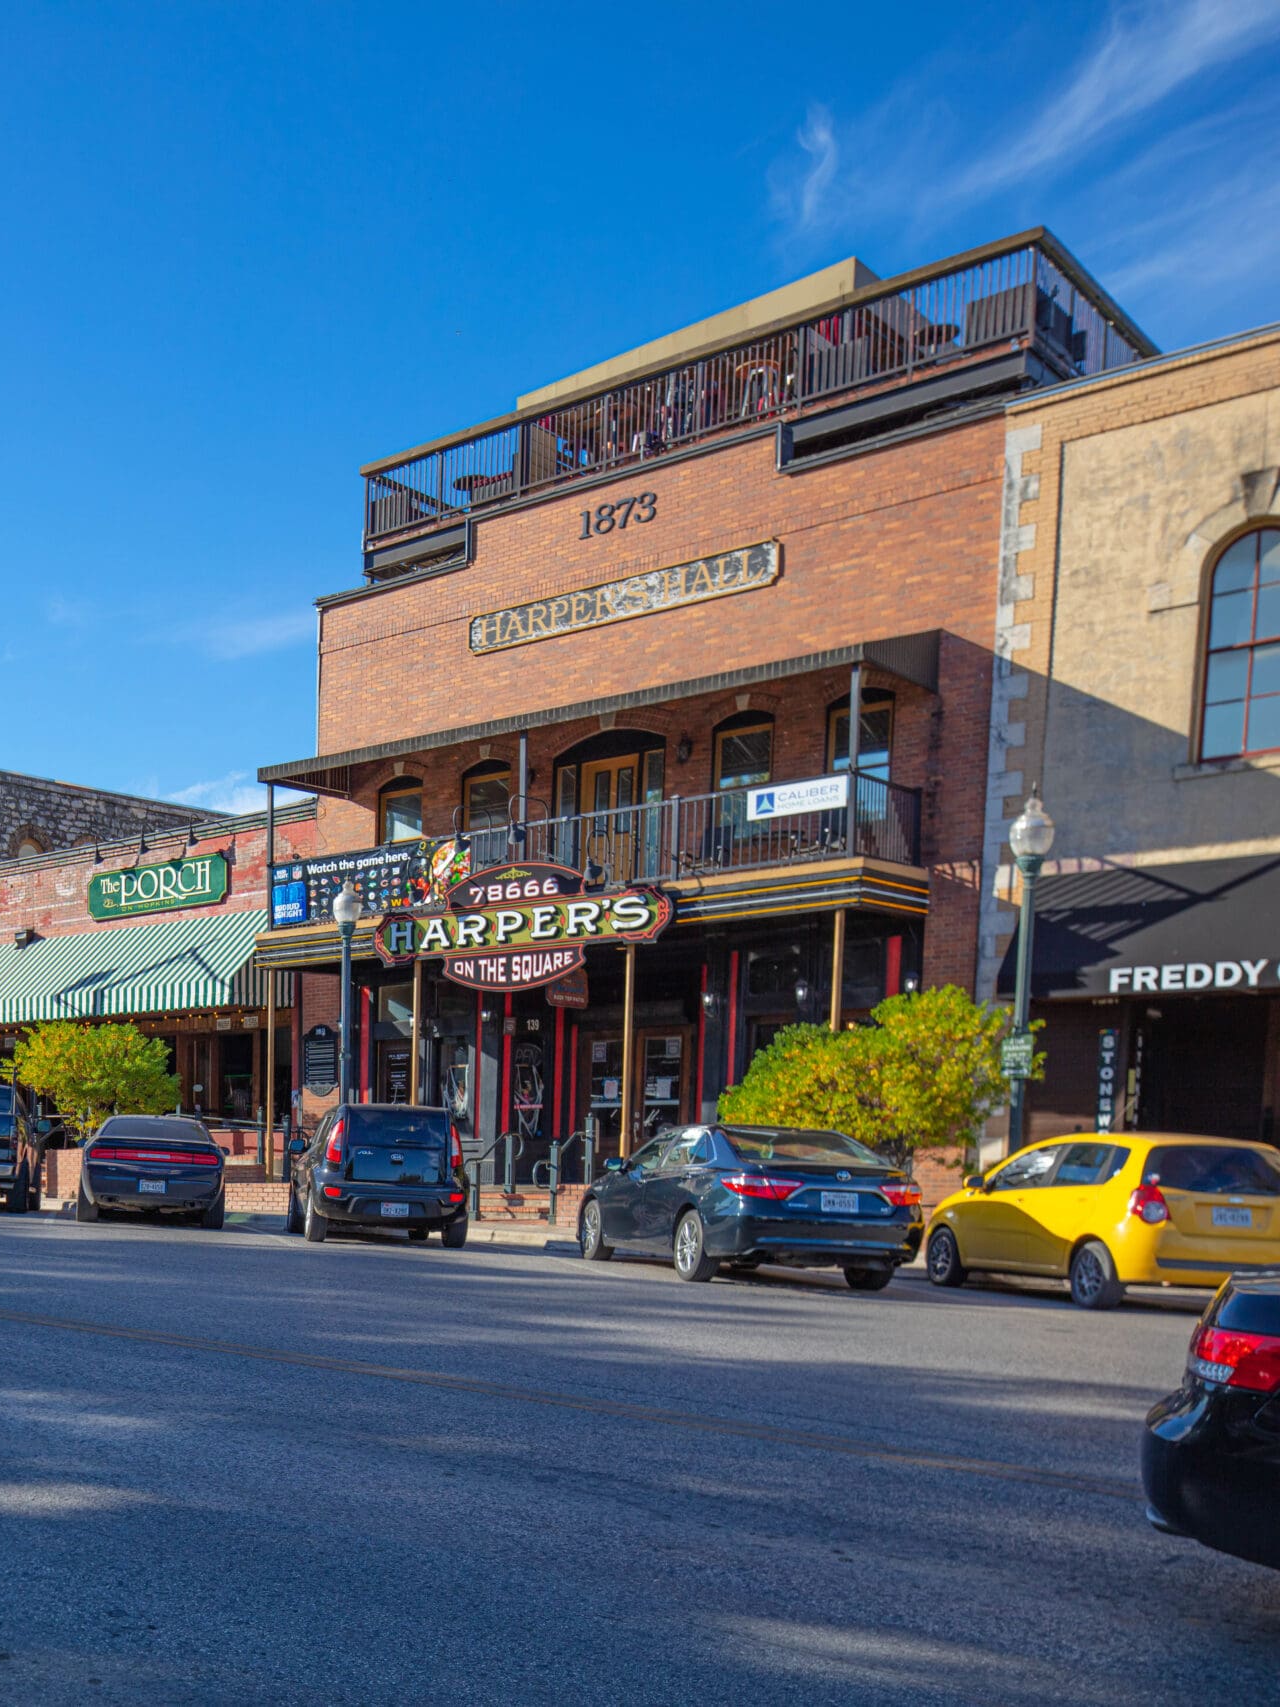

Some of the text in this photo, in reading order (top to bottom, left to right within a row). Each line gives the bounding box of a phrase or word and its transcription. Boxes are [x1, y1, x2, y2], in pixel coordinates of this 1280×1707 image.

[578, 492, 657, 540] 1873
[479, 551, 765, 647] HARPER'S HALL
[777, 784, 839, 802] CALIBER
[778, 795, 840, 810] HOME LOANS
[306, 851, 411, 875] Watch the game here.
[100, 860, 212, 906] The PORCH
[469, 877, 558, 904] 78666
[121, 899, 175, 912] ON HOPKINS
[388, 895, 651, 952] HARPER'S
[454, 951, 574, 983] ON THE SQUARE
[1109, 959, 1269, 994] FREDDY
[526, 1019, 539, 1031] 139
